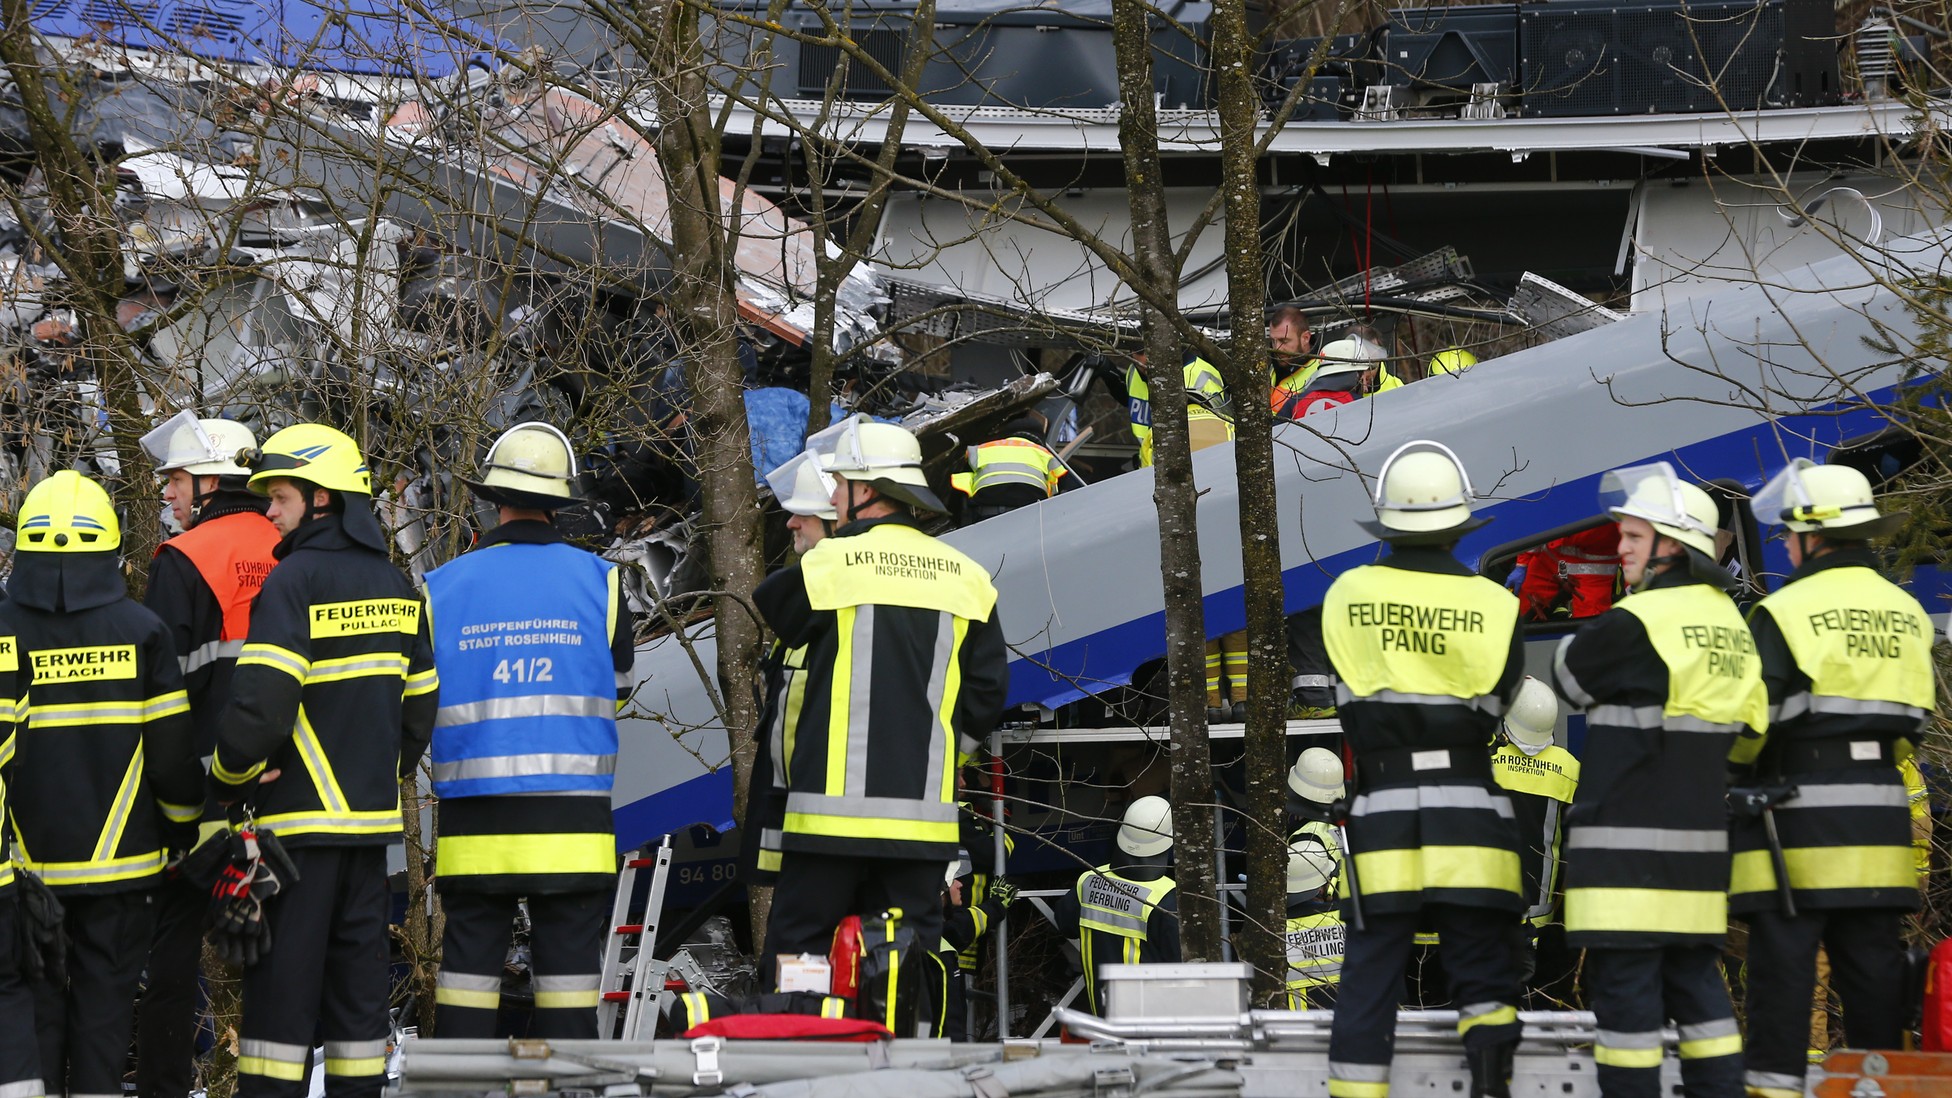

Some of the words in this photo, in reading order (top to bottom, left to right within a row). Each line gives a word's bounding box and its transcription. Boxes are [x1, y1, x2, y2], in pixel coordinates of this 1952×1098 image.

[845, 551, 875, 567] LKR
[879, 552, 961, 576] ROSENHEIM
[875, 565, 937, 581] INSPEKTION
[315, 604, 417, 622] FEUERWEHR
[1348, 602, 1484, 634] FEUERWEHR
[341, 619, 401, 632] PULLAC
[461, 618, 578, 635] GRUPPENFÜHRER
[1809, 608, 1922, 639] FEUERWEHR
[459, 636, 501, 651] STADT
[504, 633, 582, 646] ROSENHEIM
[1381, 628, 1446, 655] PANG
[1846, 633, 1900, 658] PANG
[35, 650, 131, 668] ERWEHR
[492, 657, 553, 684] 41/2
[1491, 755, 1507, 765] KR
[1508, 755, 1562, 775] ROSENHEIM
[1507, 765, 1546, 777] INSPEKTION
[680, 866, 705, 885] 94
[712, 863, 737, 881] 80
[1088, 890, 1131, 912] BERBLING
[1287, 926, 1346, 945] FEUERWEH
